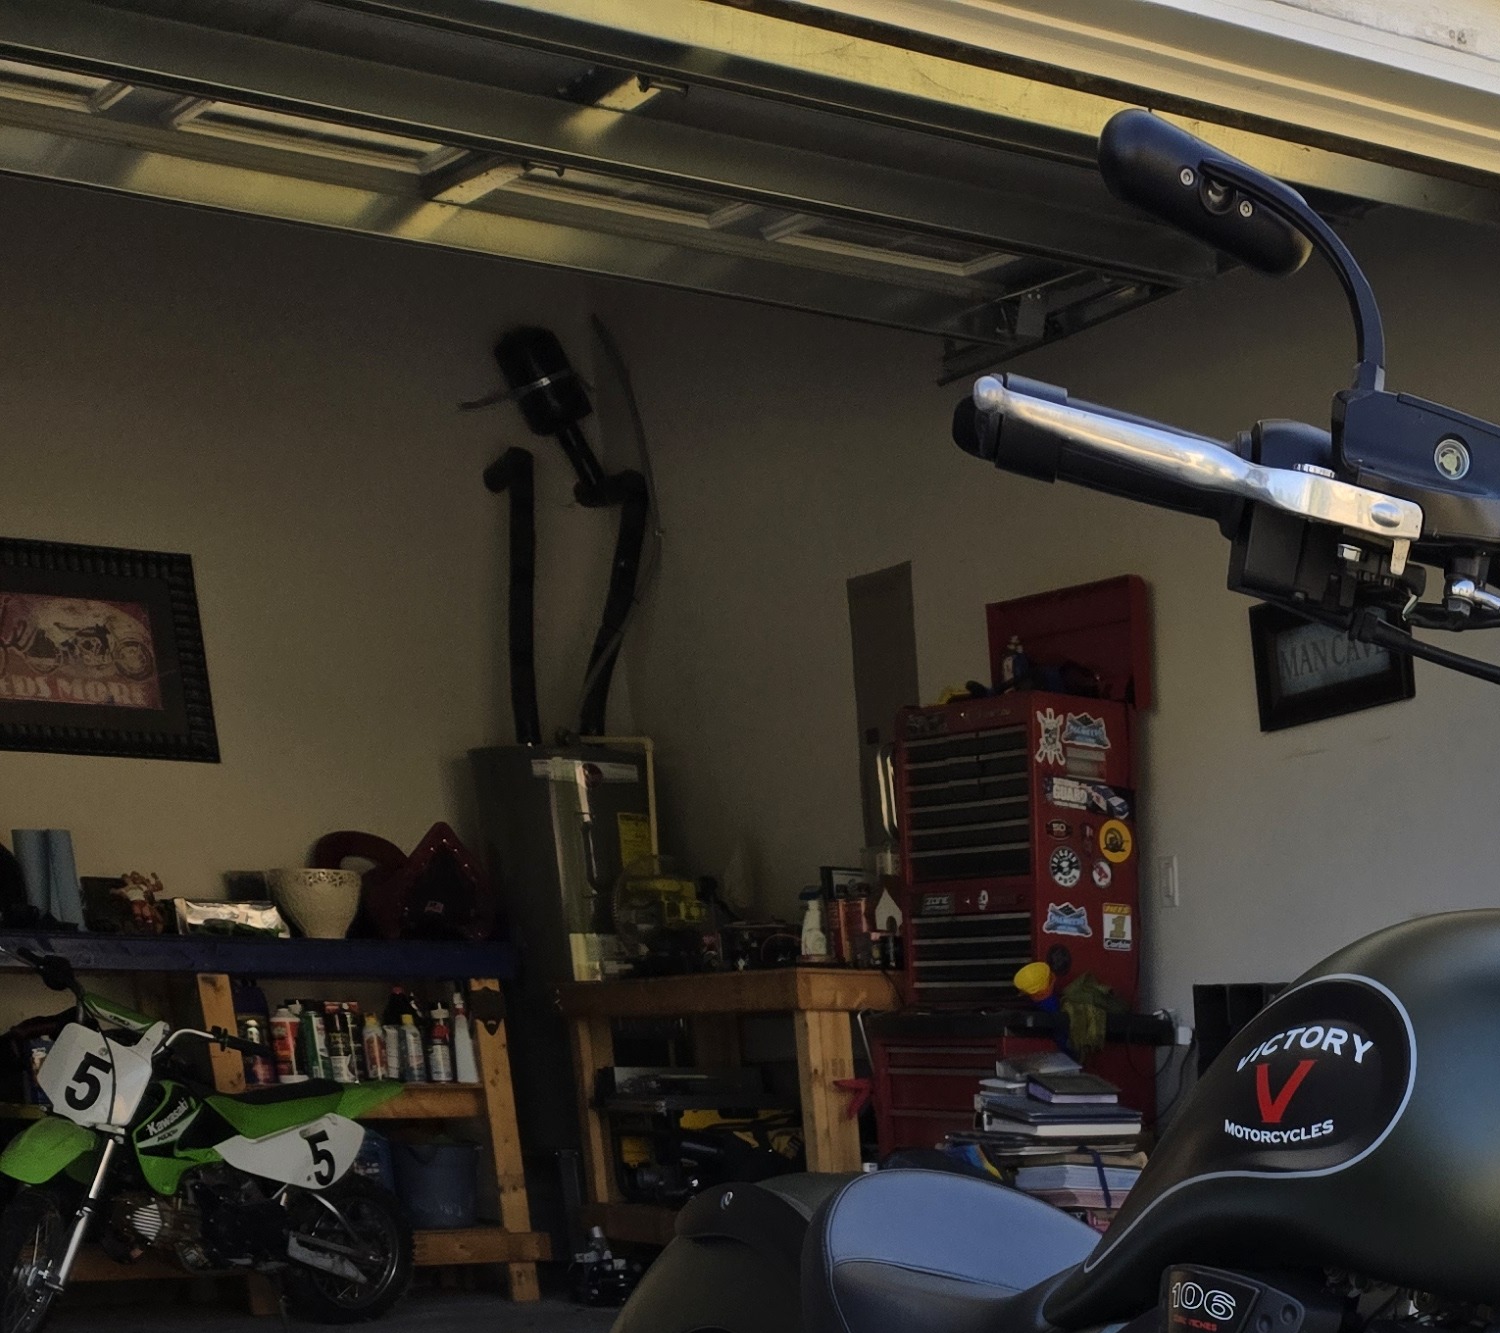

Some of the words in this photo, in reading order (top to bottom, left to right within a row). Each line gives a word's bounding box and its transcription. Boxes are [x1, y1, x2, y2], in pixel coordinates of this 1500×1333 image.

[1281, 638, 1328, 678] MAN
[1109, 916, 1126, 938] 1
[1236, 1025, 1374, 1072] VICTORY
[65, 1052, 112, 1111] 5
[1257, 1060, 1316, 1122] V
[146, 1096, 189, 1137] Kawasaki
[1224, 1118, 1333, 1144] MOTORCYCLES
[305, 1130, 336, 1186] 5
[1172, 1281, 1237, 1321] 106
